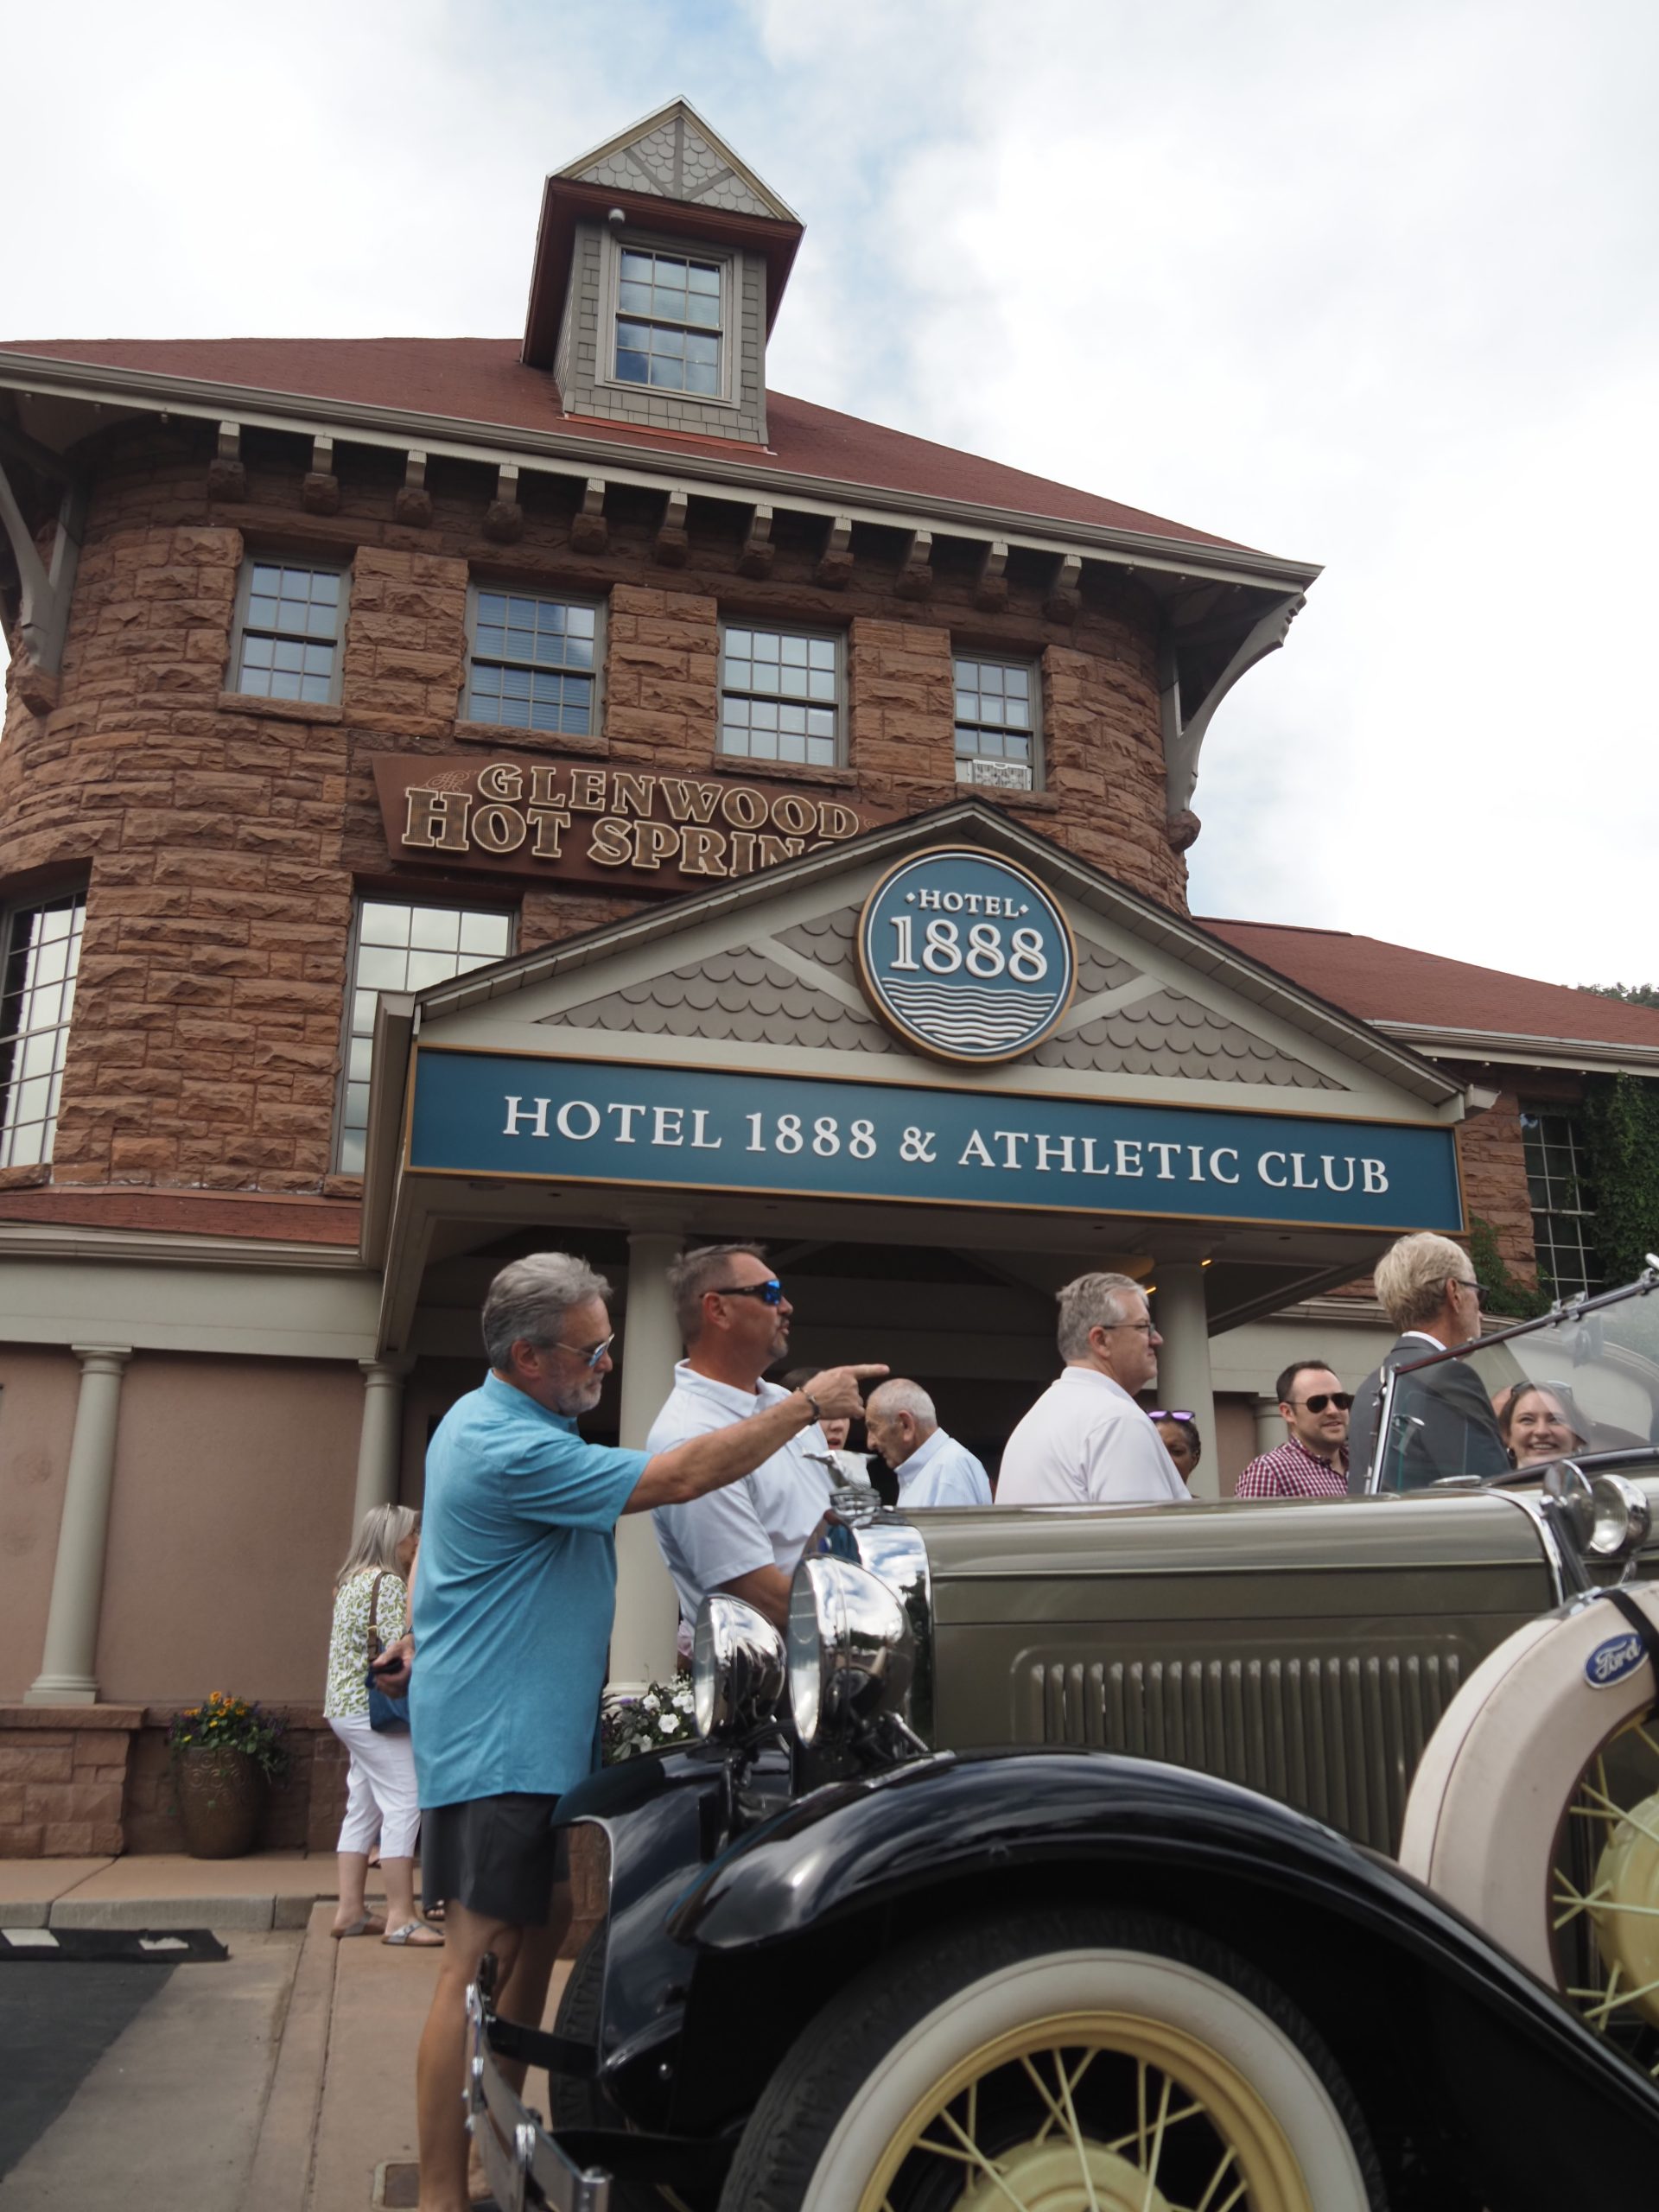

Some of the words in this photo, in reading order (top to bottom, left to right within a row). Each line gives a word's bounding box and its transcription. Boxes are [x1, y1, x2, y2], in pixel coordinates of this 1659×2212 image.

[402, 787, 570, 858] HOT
[588, 817, 835, 877] SPRIN
[478, 763, 859, 839] GLENWOOD
[918, 889, 1020, 918] HOTEL
[889, 916, 1048, 982] 1888
[503, 1096, 722, 1149] HOTEL
[746, 1112, 878, 1160] 1888
[899, 1126, 938, 1164] &
[958, 1129, 1240, 1185] ATHLETIC
[1257, 1151, 1389, 1194] CLUB
[1595, 1637, 1642, 1681] Ford
